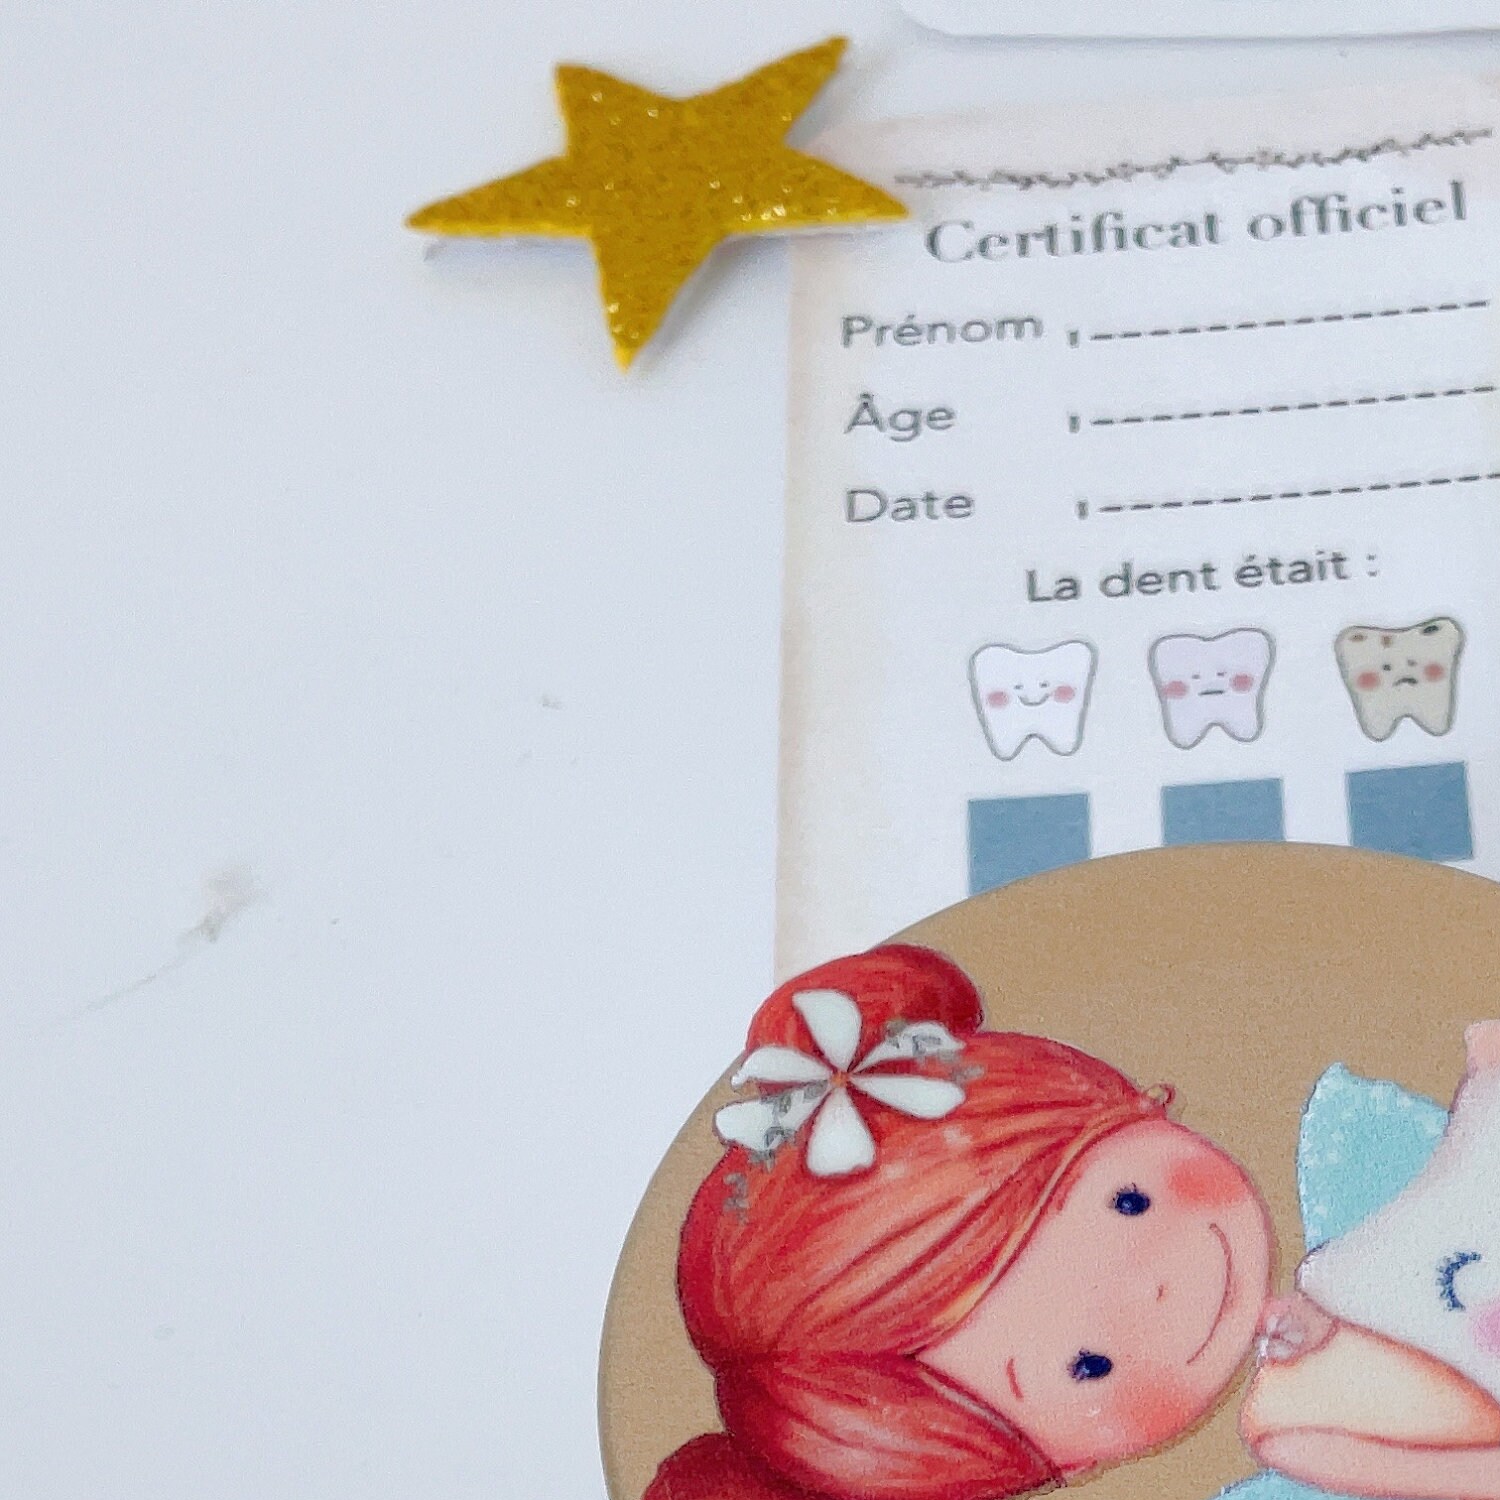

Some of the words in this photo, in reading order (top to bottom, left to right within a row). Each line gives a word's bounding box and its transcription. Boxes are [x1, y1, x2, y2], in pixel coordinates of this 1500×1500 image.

[925, 211, 1222, 262] Certificat
[1247, 180, 1467, 240] officiel
[842, 313, 1044, 349] Prénom
[844, 392, 956, 442] Âge
[846, 489, 975, 524] Date
[1026, 569, 1082, 603] La
[1099, 561, 1221, 599] dent
[1235, 550, 1350, 588] était
